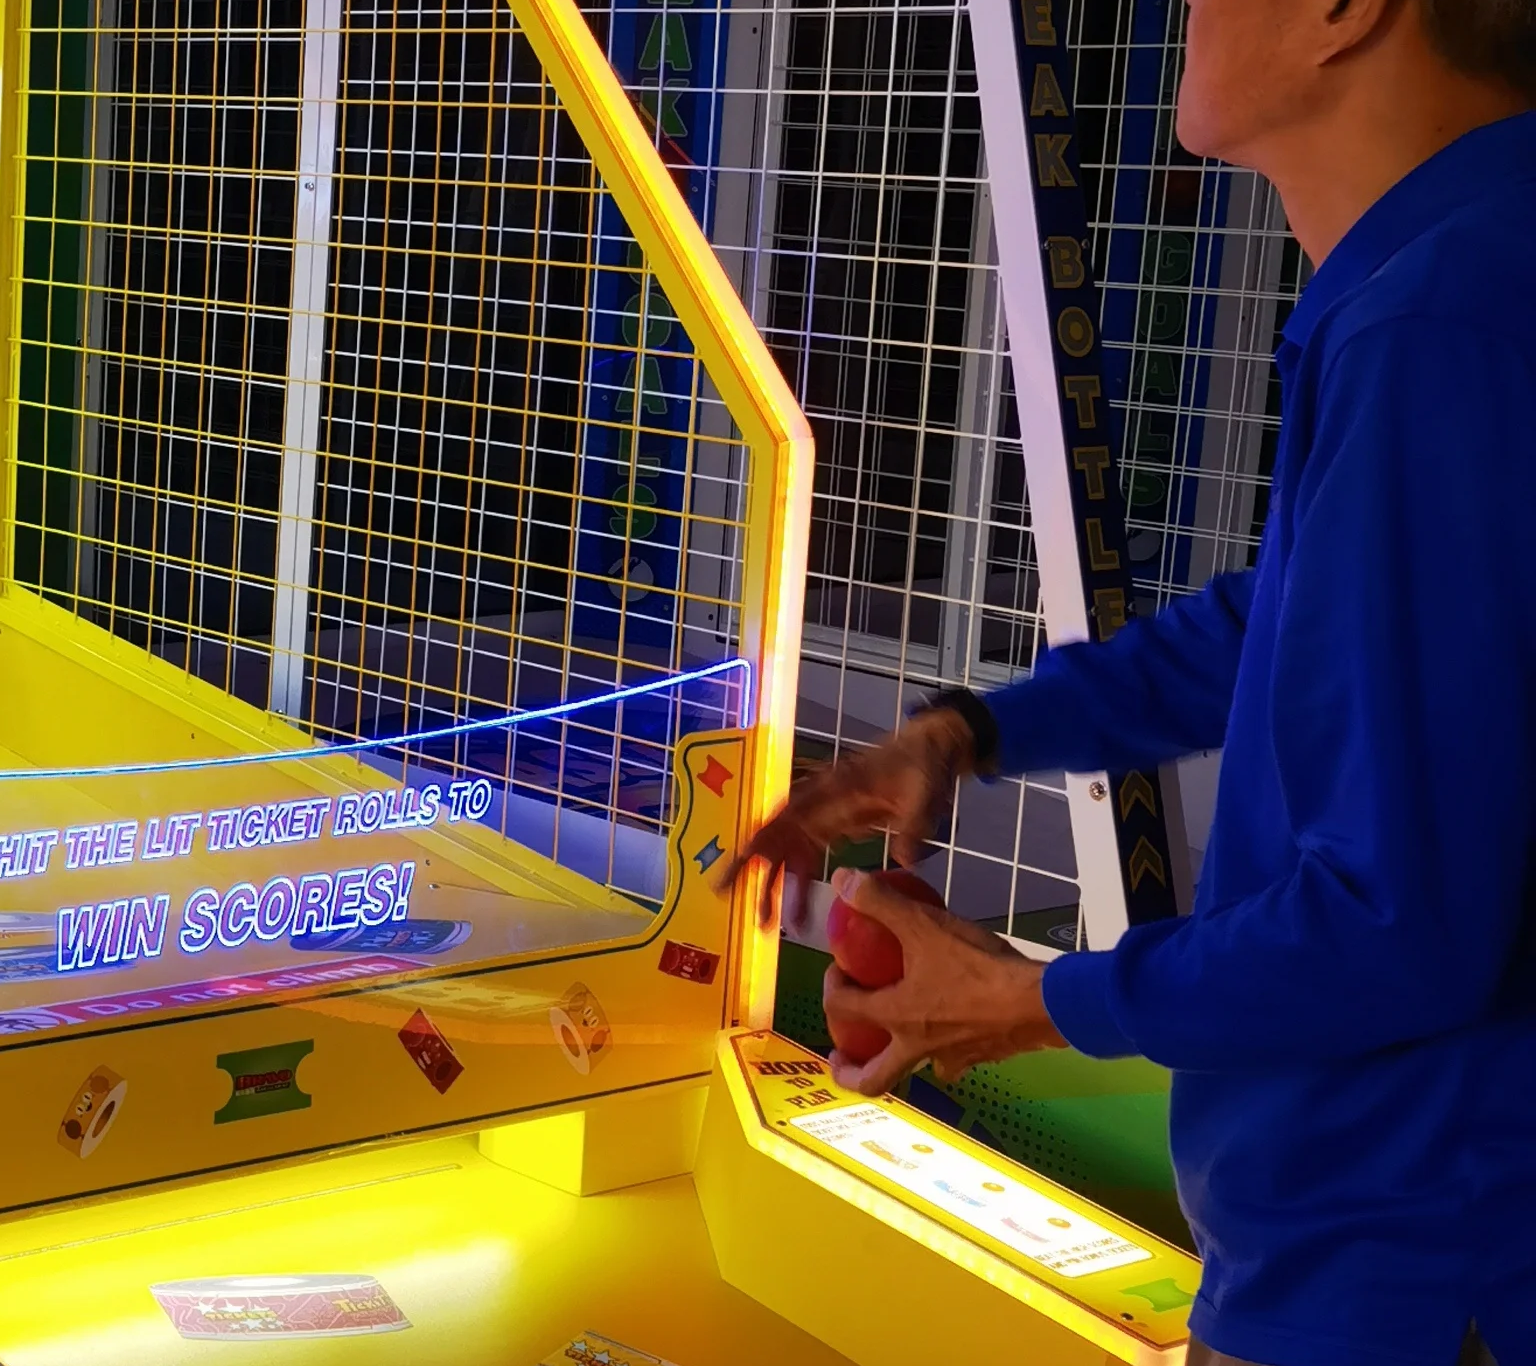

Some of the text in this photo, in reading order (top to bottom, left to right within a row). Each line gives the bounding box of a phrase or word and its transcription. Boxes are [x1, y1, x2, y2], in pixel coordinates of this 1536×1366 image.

[1048, 234, 1130, 642] BOTTLE
[65, 818, 139, 870] THE
[141, 810, 202, 861] LIT
[207, 796, 332, 851] TICKET
[334, 783, 442, 836] ROLLS
[448, 777, 493, 822] TO
[57, 860, 416, 973] WIN SCORES!
[78, 955, 401, 1019] Do not climb
[751, 1060, 826, 1076] HOW
[784, 1077, 815, 1089] TO
[784, 1088, 840, 1109] PLAY
